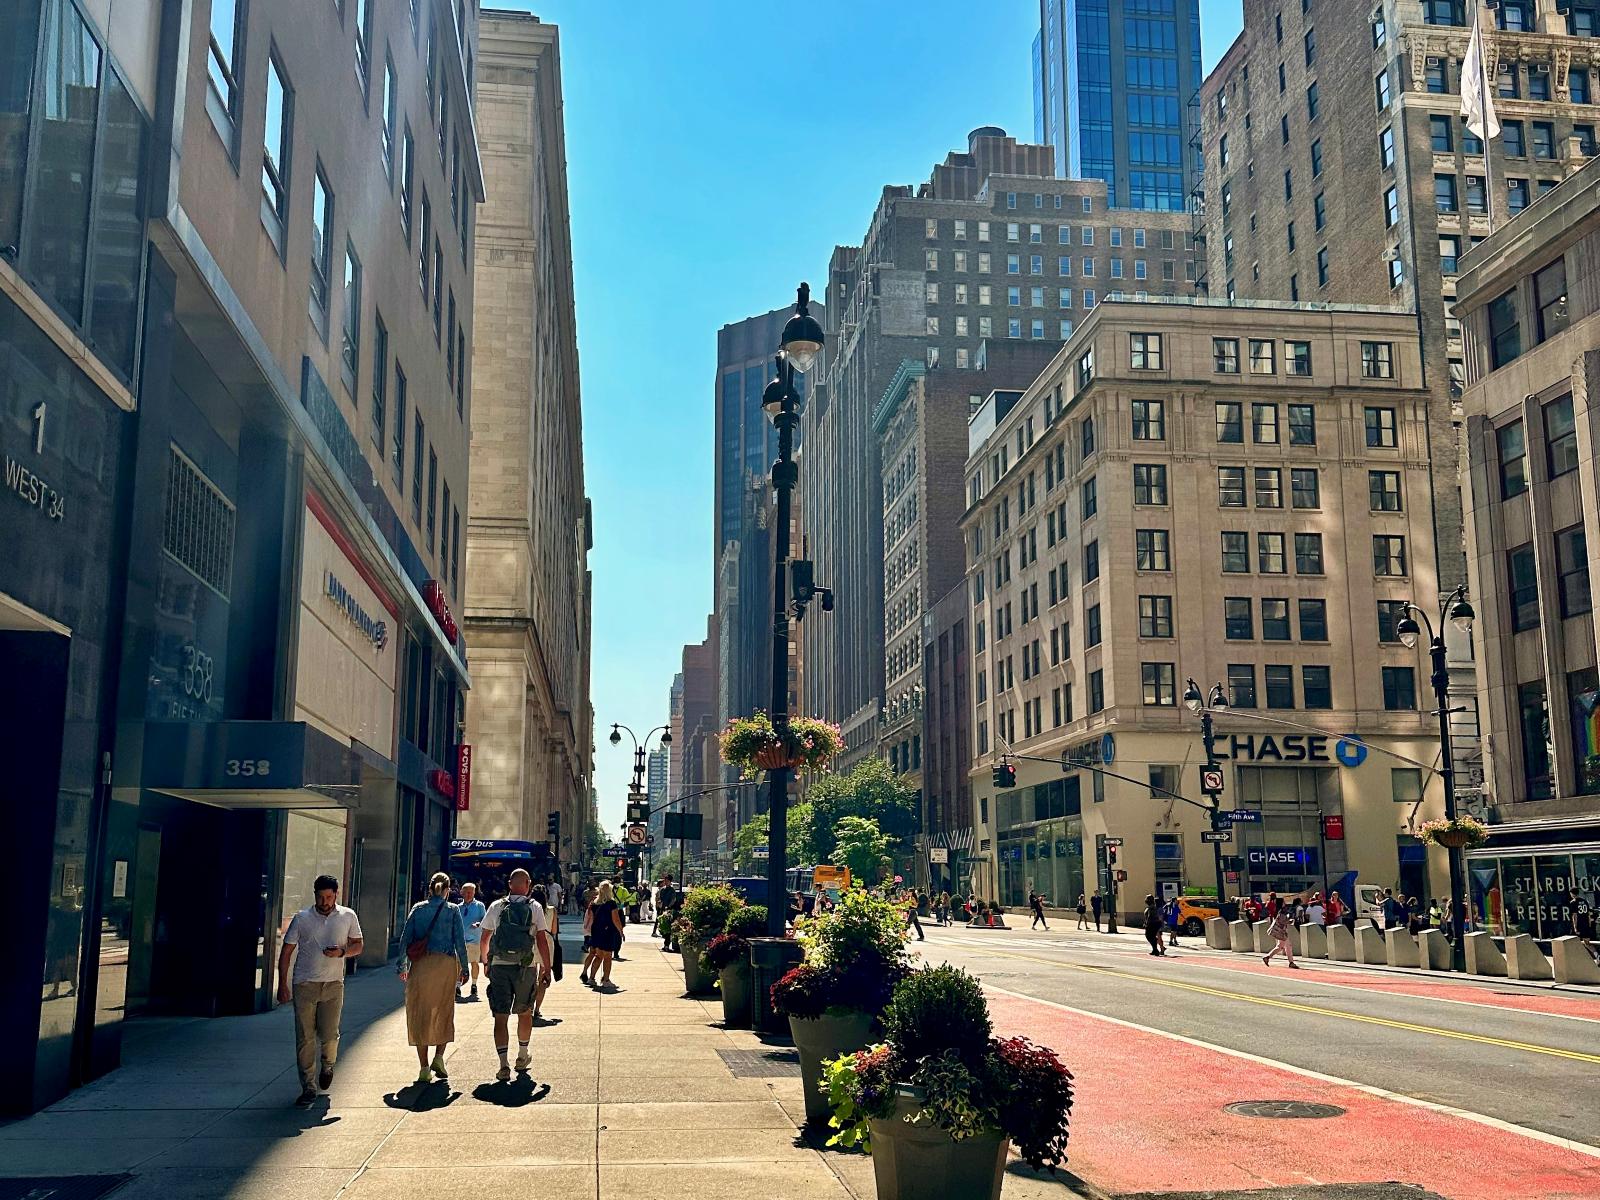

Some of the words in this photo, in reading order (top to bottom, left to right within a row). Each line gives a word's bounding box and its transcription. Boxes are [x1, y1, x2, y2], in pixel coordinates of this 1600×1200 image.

[35, 402, 46, 455] 1
[6, 455, 48, 510] WEST
[49, 490, 64, 521] 34
[184, 645, 213, 703] 358
[1212, 735, 1330, 761] CHASE
[226, 759, 270, 776] 358
[461, 756, 469, 774] CVS
[451, 839, 475, 849] ergy
[475, 839, 494, 848] bus
[1250, 852, 1296, 863] CHASE
[1578, 904, 1588, 914] 30
